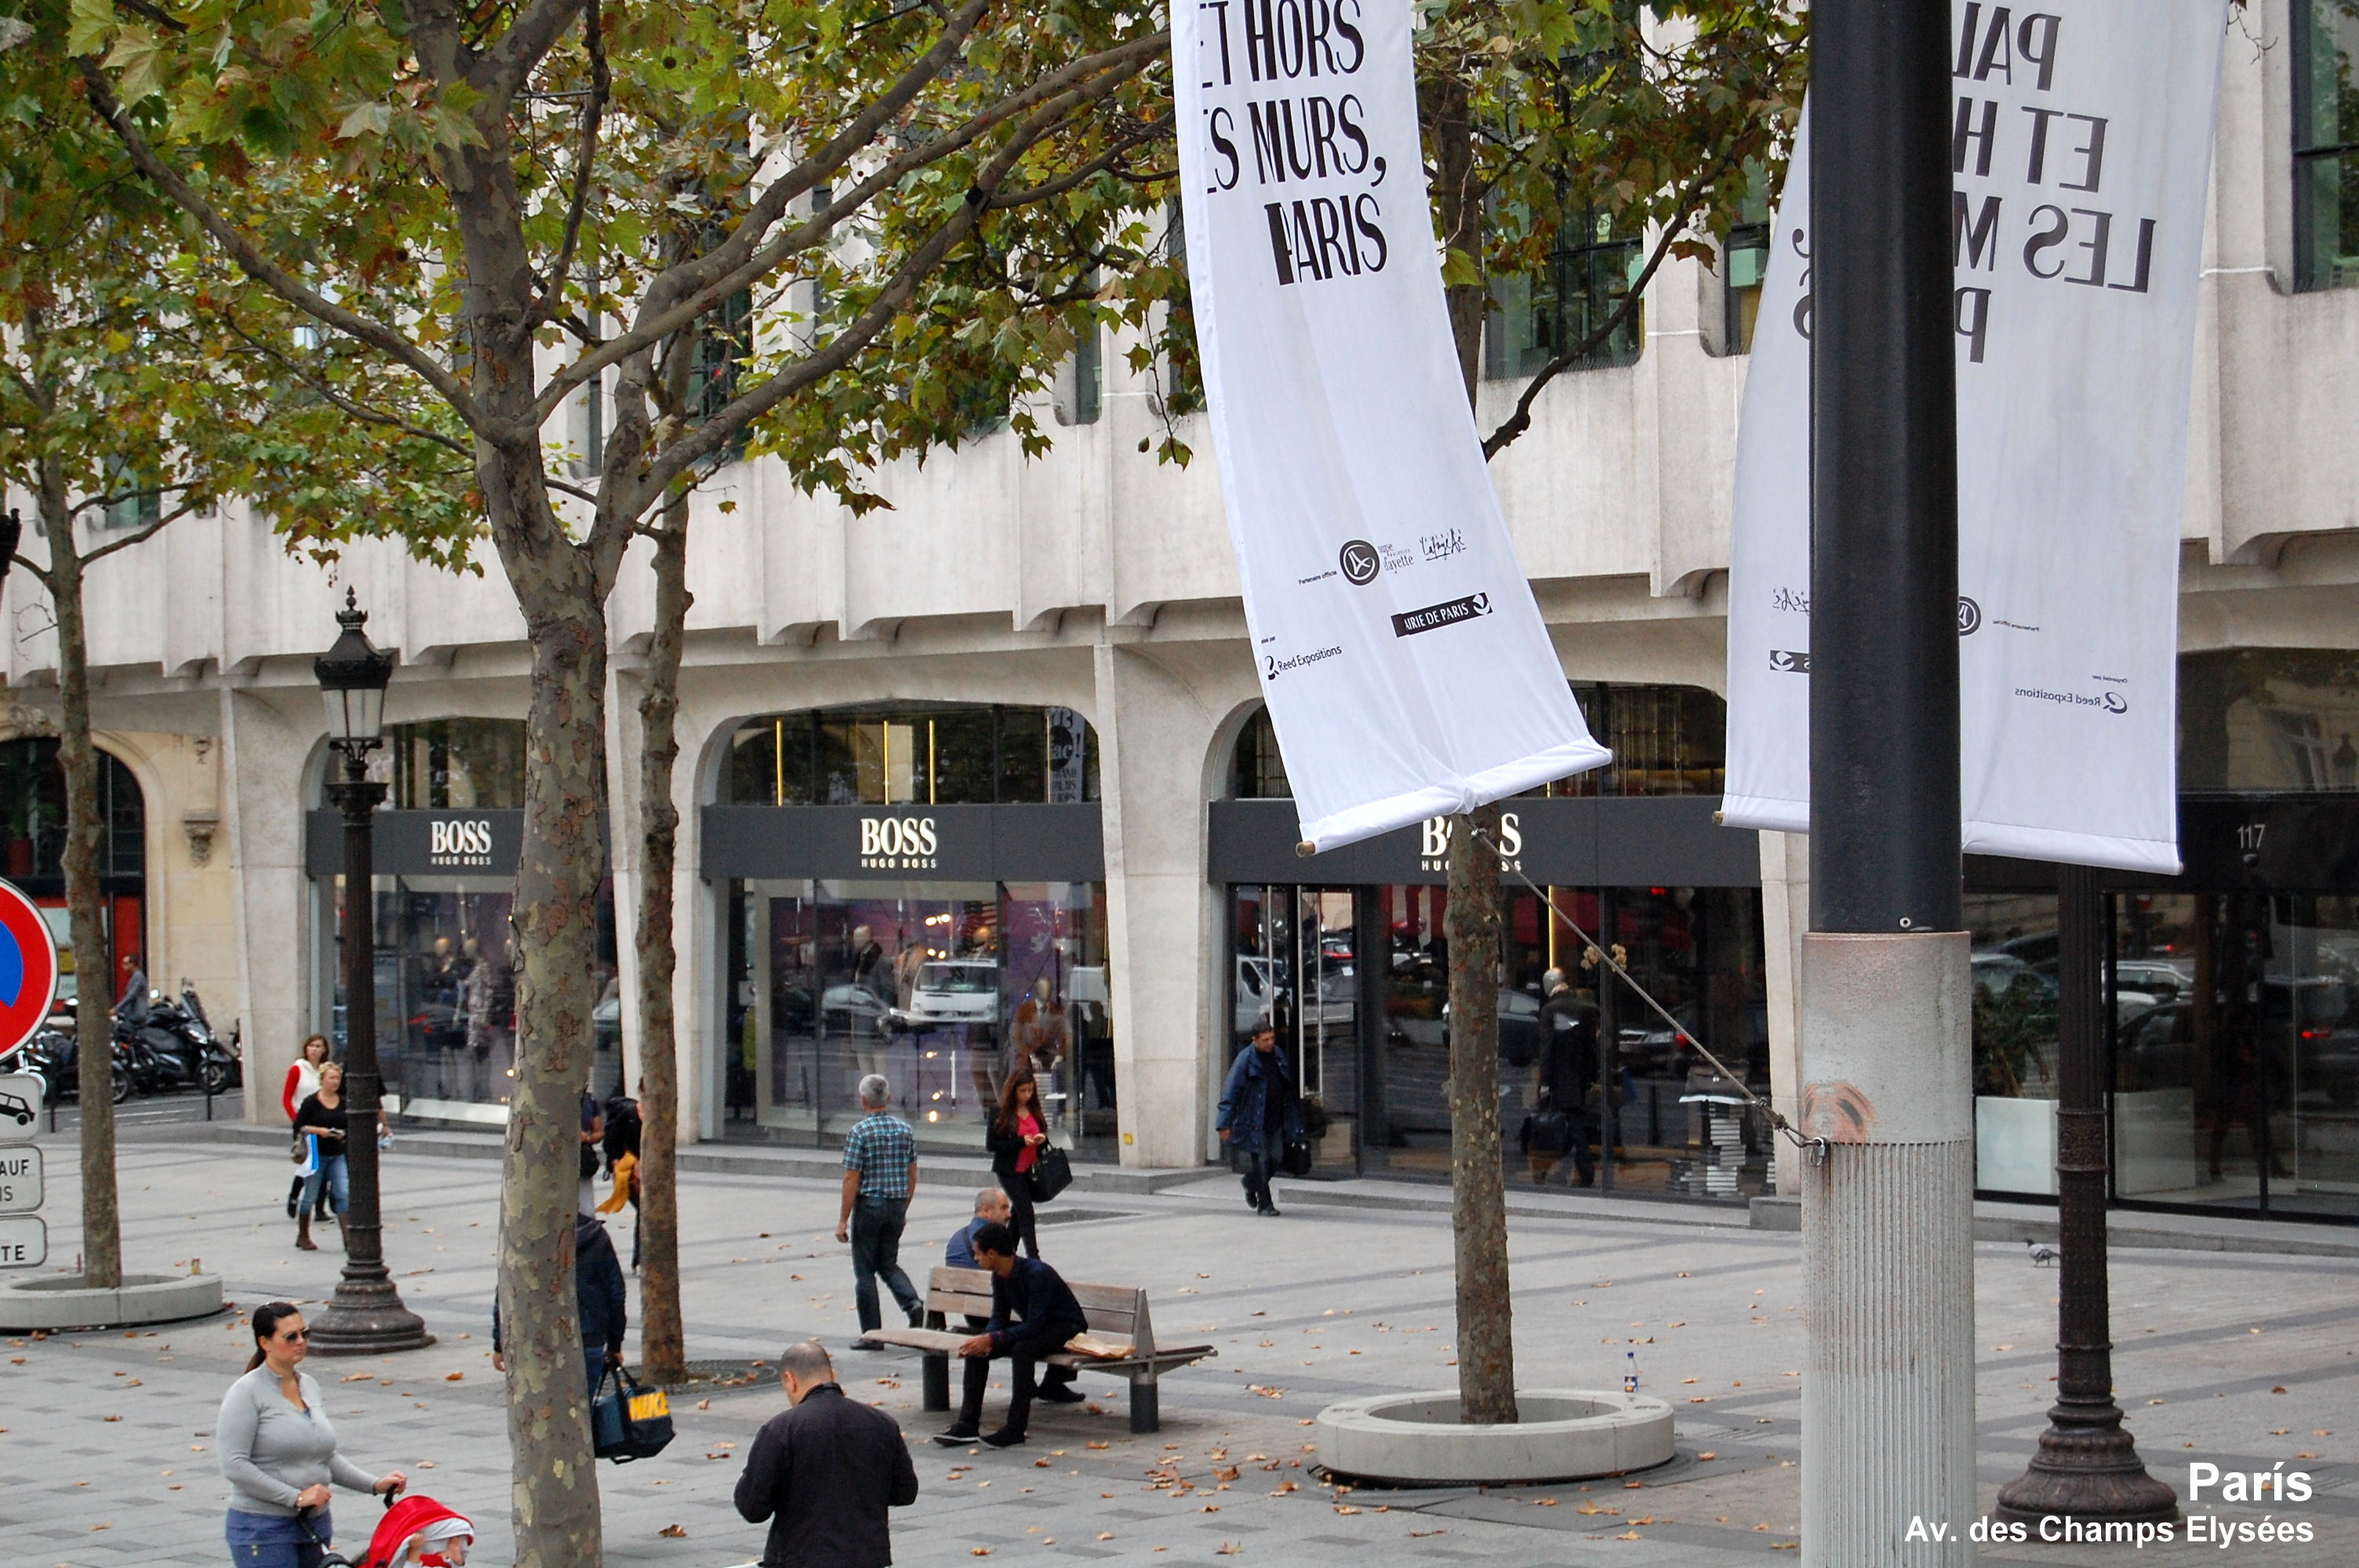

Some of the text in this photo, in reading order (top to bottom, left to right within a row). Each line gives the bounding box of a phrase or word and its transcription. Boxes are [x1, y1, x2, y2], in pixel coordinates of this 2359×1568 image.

[1200, 0, 1365, 88] T HORS
[1247, 93, 1387, 187] MURS,
[1264, 193, 1387, 285] PARIS
[1383, 555, 1414, 574] fayette
[1404, 602, 1469, 630] AIRIE DE PARIS
[1278, 646, 1342, 672] Reed Expositions
[431, 820, 492, 854] BOSS
[860, 817, 937, 856] BOSS
[1421, 812, 1522, 857] BS
[2237, 824, 2266, 849] 117
[861, 858, 936, 869] HUGO BOSS
[0, 1159, 30, 1176] AUF
